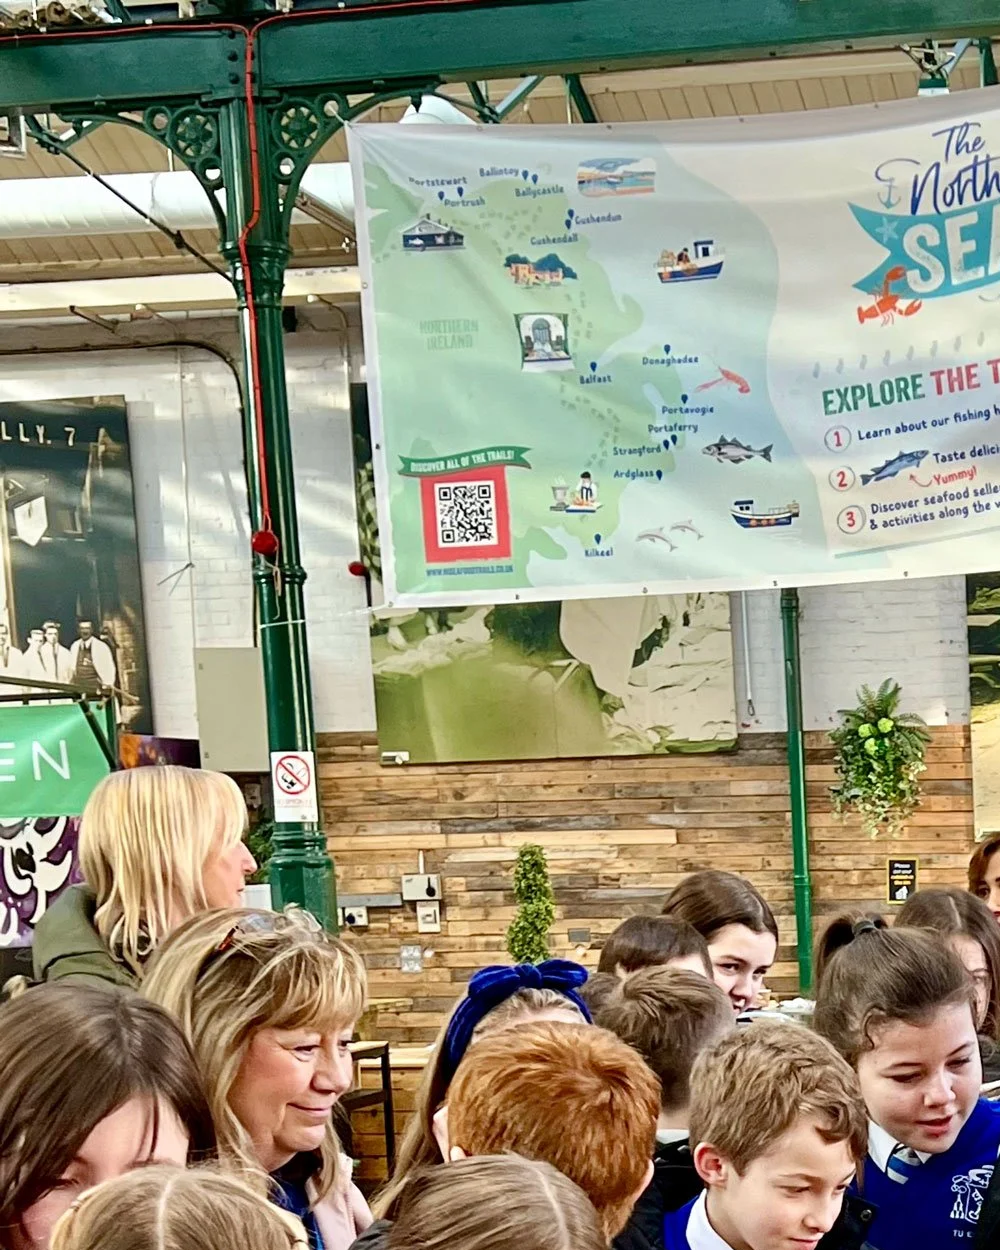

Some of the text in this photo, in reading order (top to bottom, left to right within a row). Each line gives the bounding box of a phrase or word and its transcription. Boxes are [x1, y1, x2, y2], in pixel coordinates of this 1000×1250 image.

[932, 121, 986, 162] The
[479, 167, 519, 177] Ballintoy
[515, 185, 564, 198] Ballycastle
[444, 196, 485, 207] Portrush
[575, 212, 622, 225] Cushendun
[530, 233, 578, 245] Cushendall
[642, 355, 699, 367] Donaghadee
[579, 375, 612, 384] Belfast
[822, 373, 926, 416] EXPLORE
[930, 363, 981, 396] THE
[661, 406, 714, 416] Portavogie
[647, 423, 699, 433] Portaferry
[857, 426, 892, 441] Learn
[894, 419, 928, 434] about
[931, 416, 951, 428] our
[953, 407, 991, 424] fishing
[63, 426, 76, 446] 7
[613, 446, 661, 456] Strangford
[446, 459, 460, 469] ALL
[460, 456, 470, 467] OF
[471, 454, 486, 464] THE
[933, 451, 967, 465] Taste
[613, 469, 654, 480] Ardglass
[933, 465, 977, 486] Yummy!
[870, 498, 920, 515] Discover
[923, 487, 970, 505] seafood
[869, 519, 879, 531] &
[881, 509, 935, 529] activities
[938, 504, 970, 520] along
[972, 500, 992, 514] the
[584, 547, 614, 558] Kilkeel
[953, 1229, 964, 1238] TU
